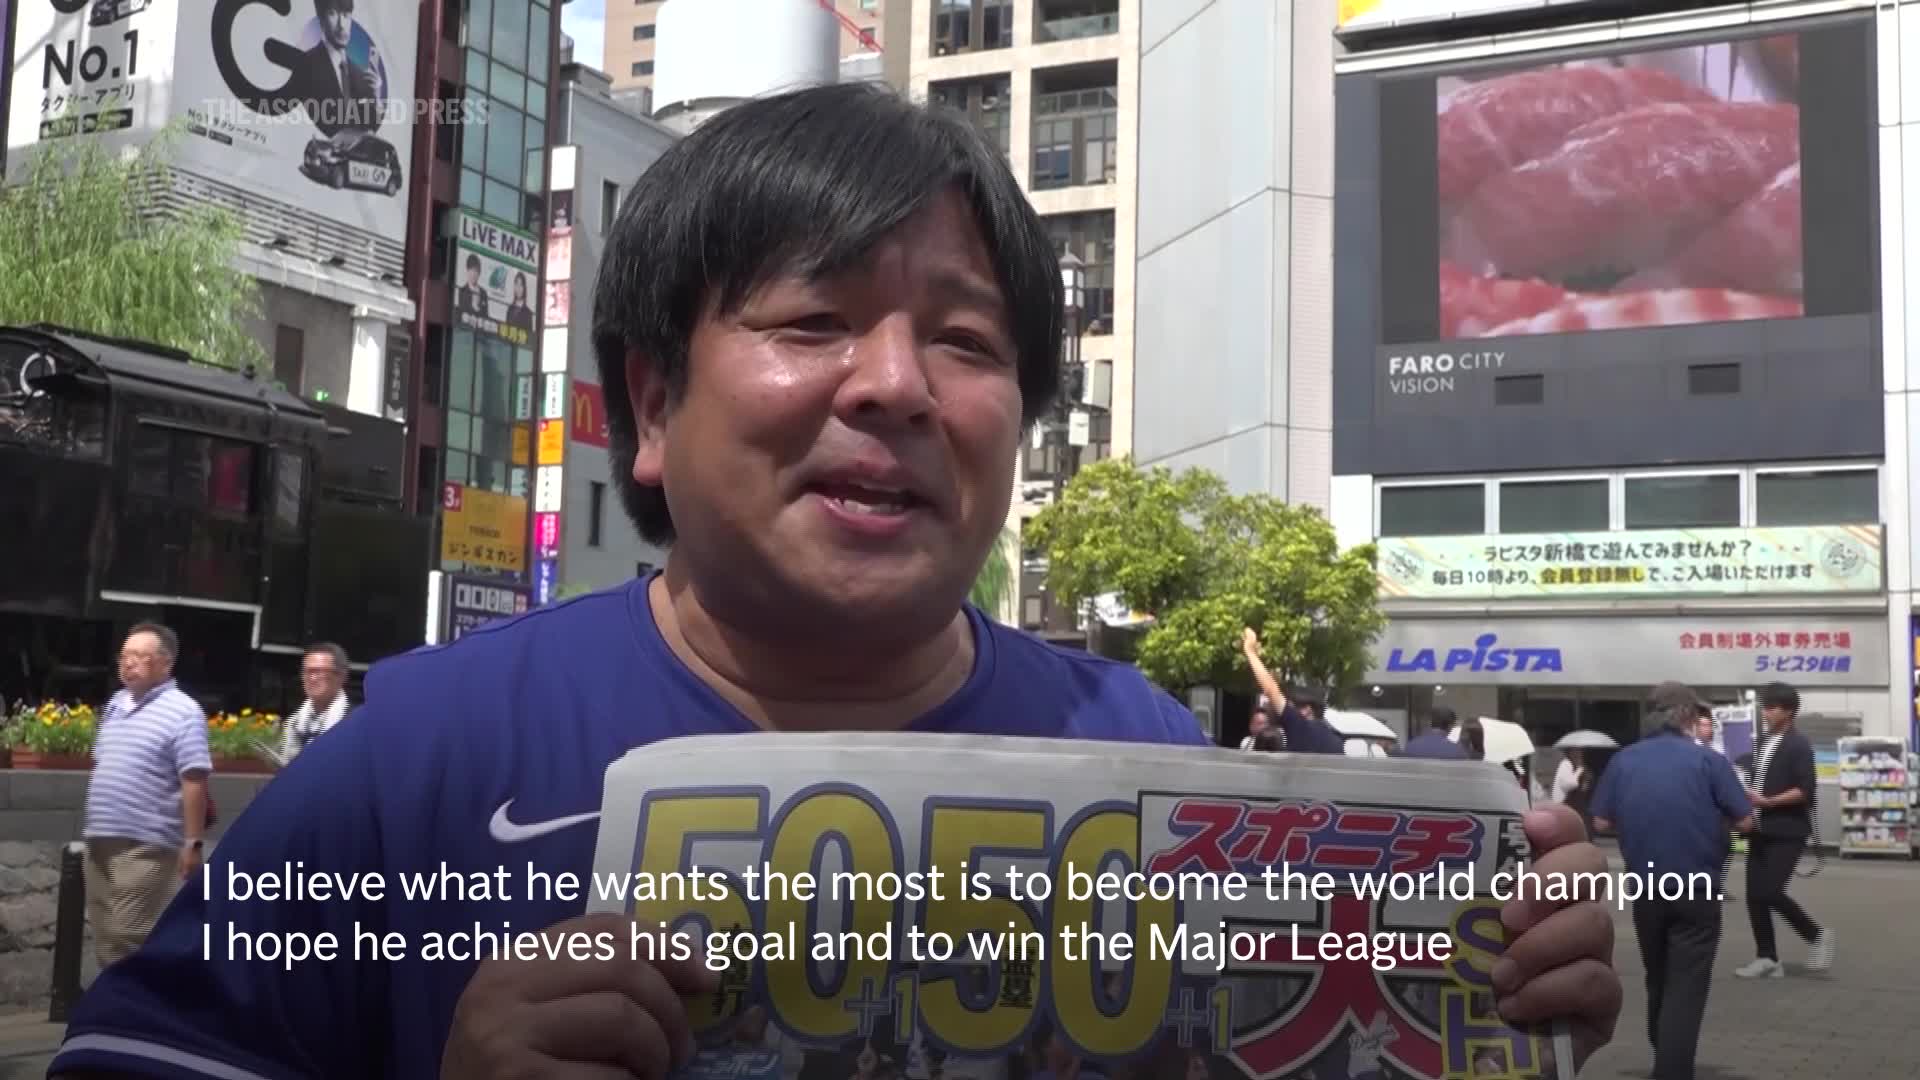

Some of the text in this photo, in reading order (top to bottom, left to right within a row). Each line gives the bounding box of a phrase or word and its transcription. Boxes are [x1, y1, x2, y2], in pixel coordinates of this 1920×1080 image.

[43, 30, 138, 89] No.1
[500, 233, 536, 263] MAX
[1389, 352, 1505, 375] FARO CITY
[1390, 376, 1455, 393] VISION
[1679, 631, 1851, 649] 会員制場外車券売場
[1386, 648, 1437, 672] LA
[1149, 798, 1485, 886] スポニチ
